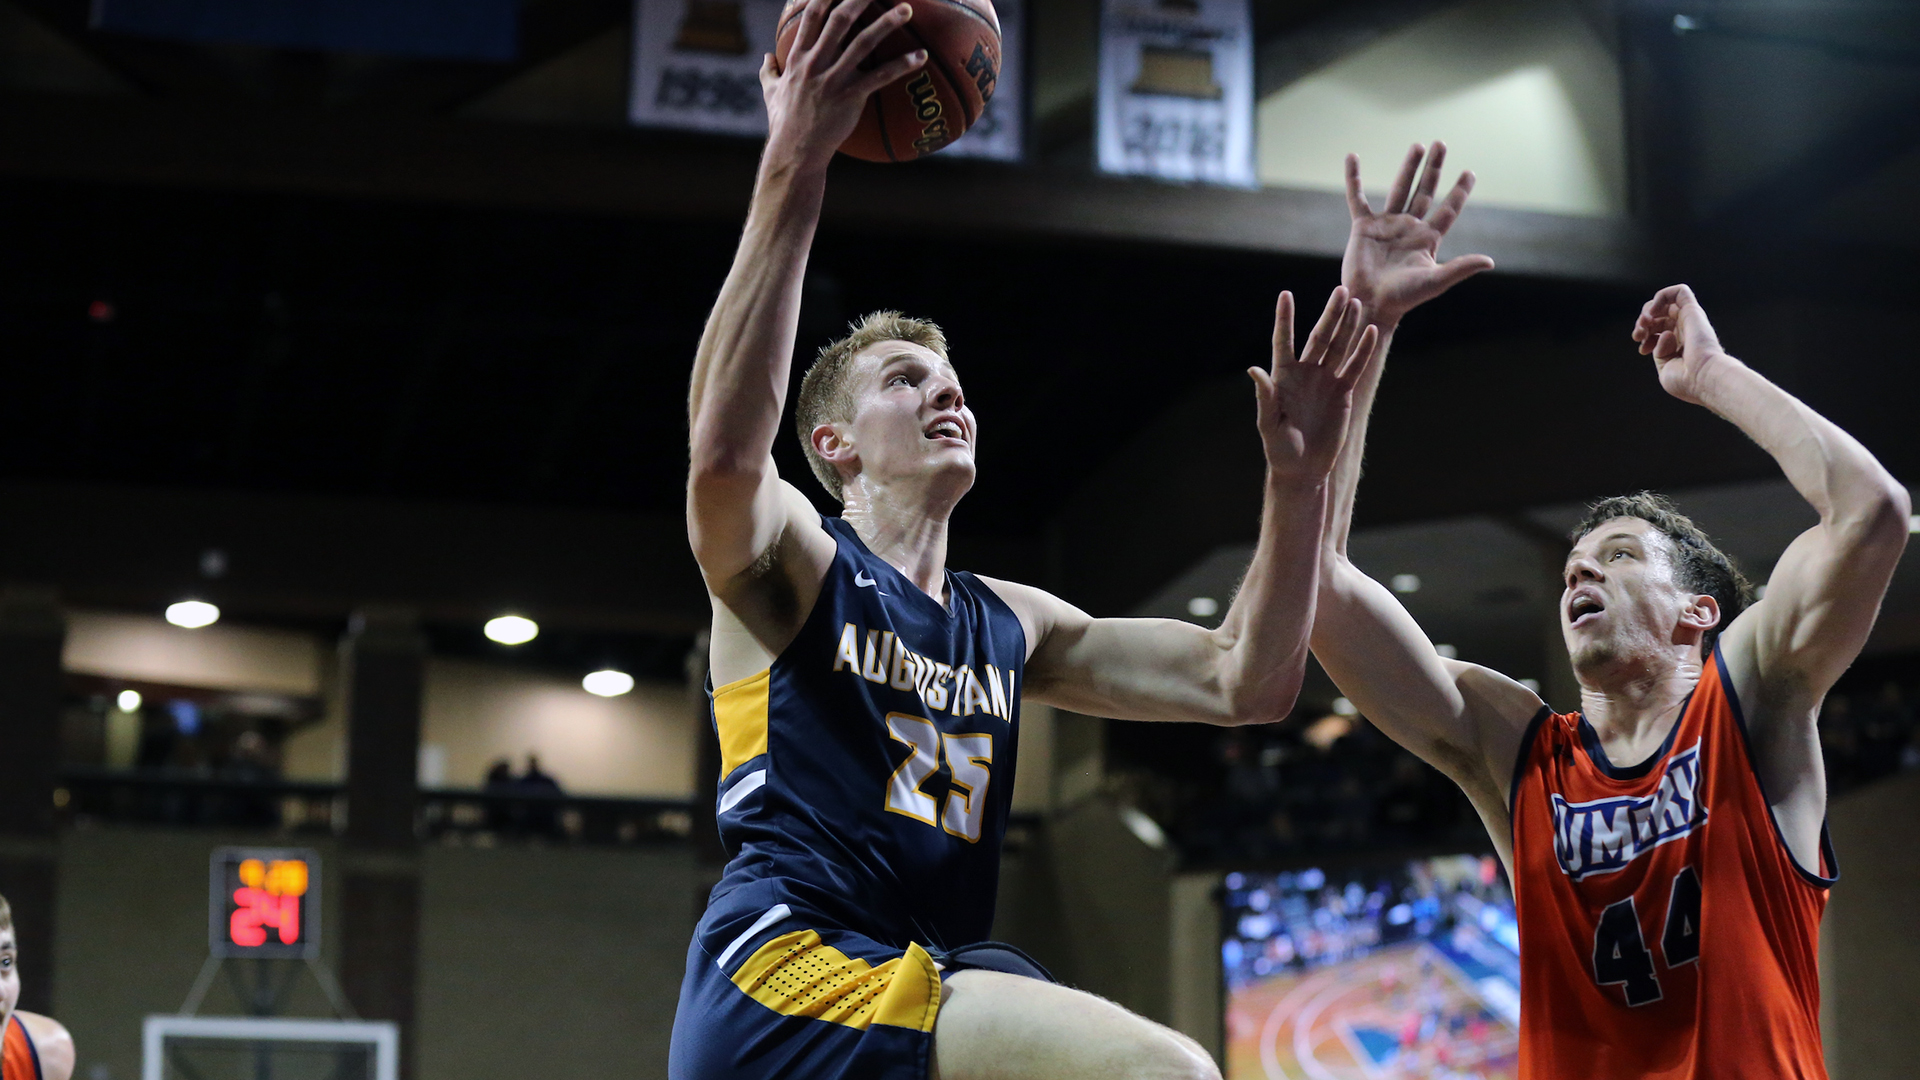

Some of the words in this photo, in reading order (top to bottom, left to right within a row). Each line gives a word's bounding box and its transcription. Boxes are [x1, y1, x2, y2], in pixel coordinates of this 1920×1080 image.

[883, 711, 993, 844] 25
[230, 887, 300, 947] 24
[1592, 865, 1703, 1007] 44
